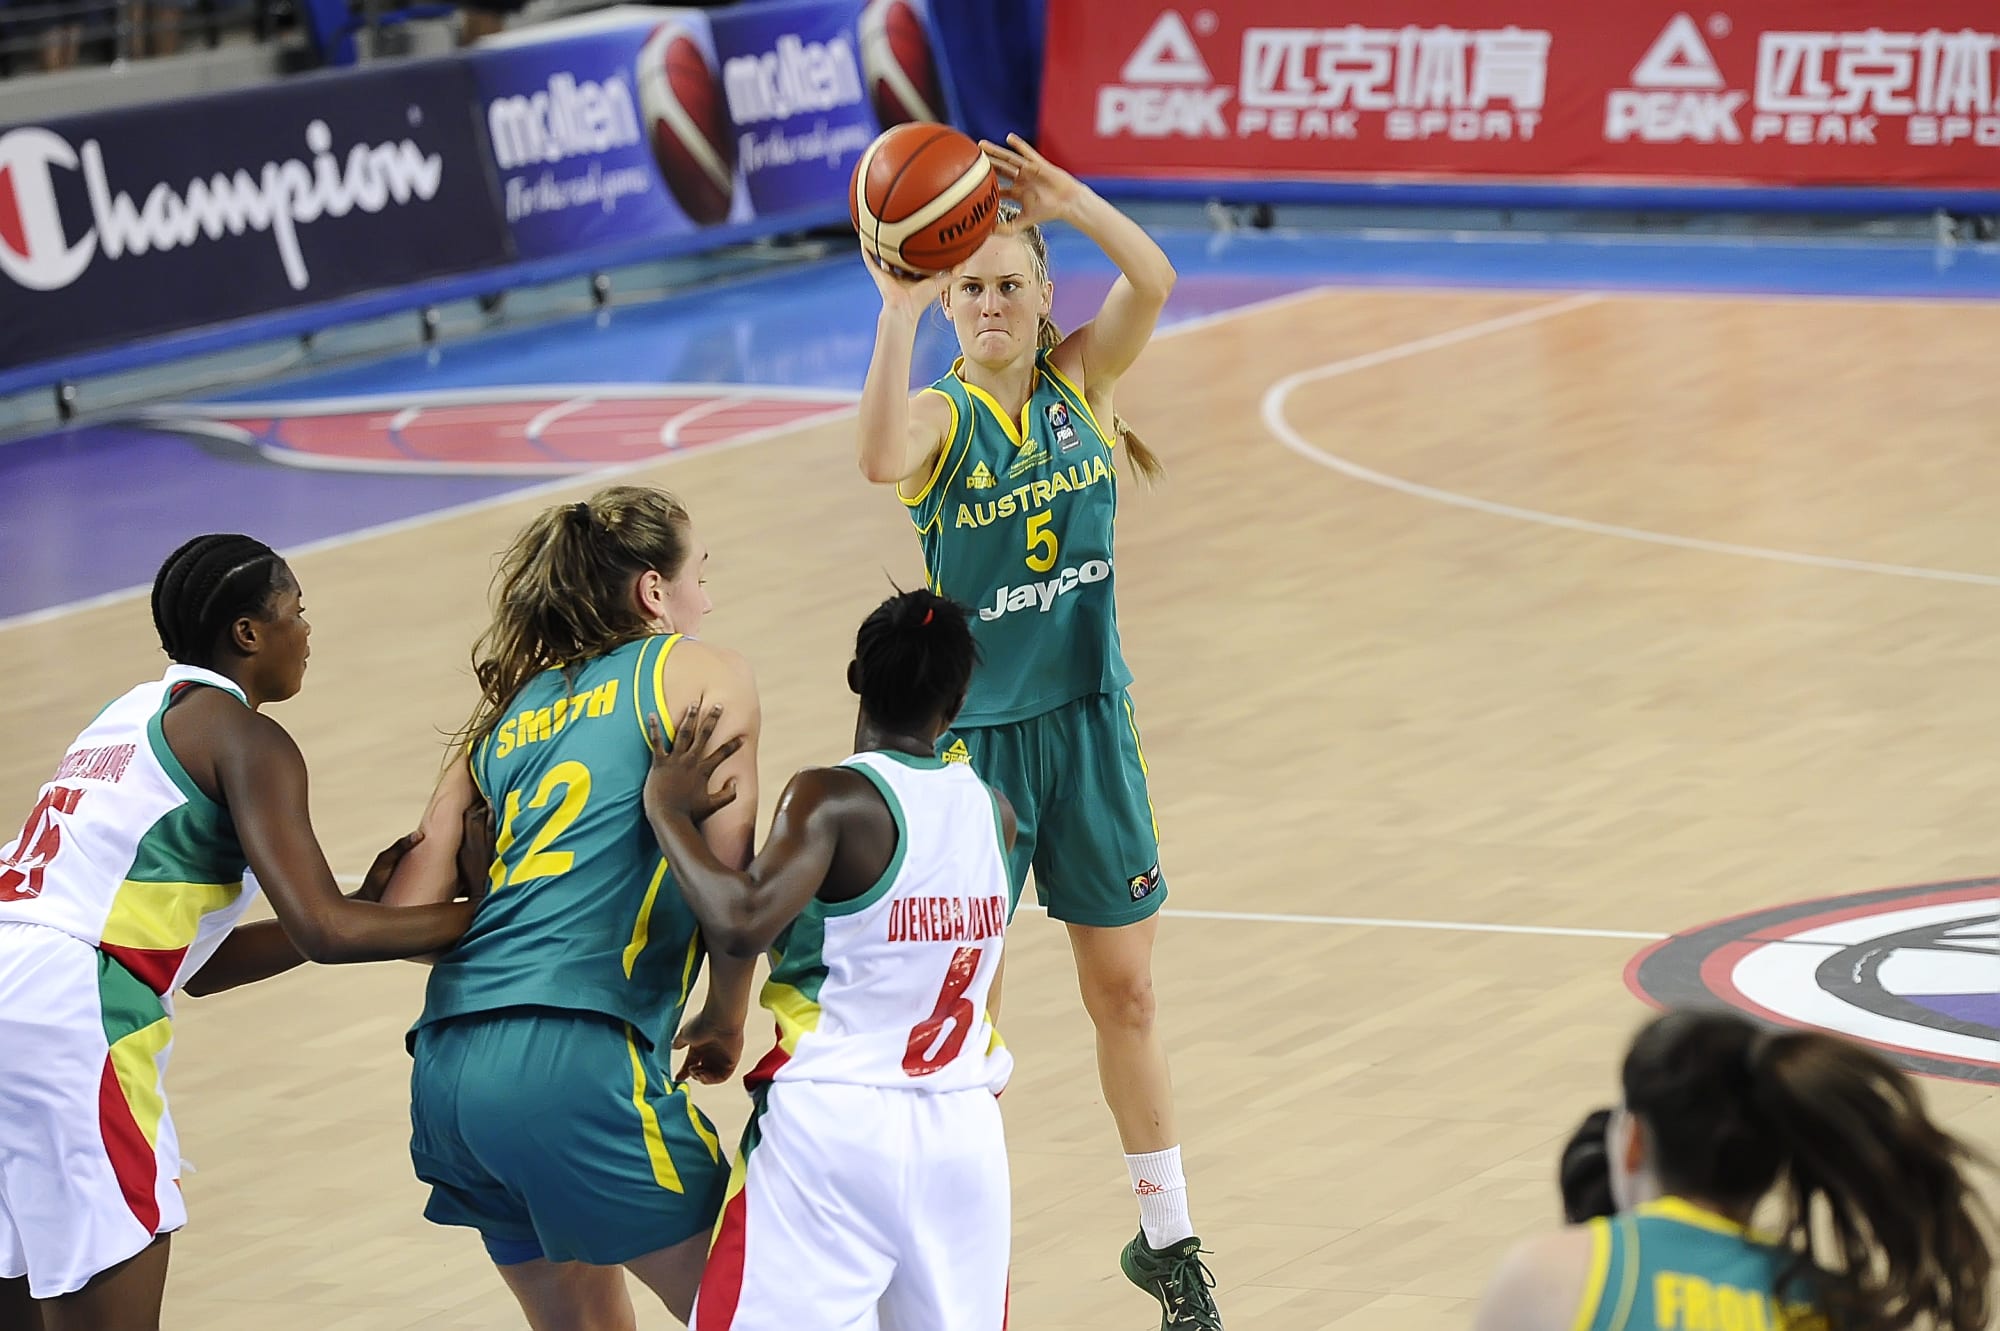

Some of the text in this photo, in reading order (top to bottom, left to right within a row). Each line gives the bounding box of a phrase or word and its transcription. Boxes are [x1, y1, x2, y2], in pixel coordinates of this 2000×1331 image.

[724, 35, 863, 125] molten
[1241, 25, 1552, 110] 匹克体育
[1754, 28, 2000, 115] 匹克体
[488, 71, 641, 169] molten
[1097, 85, 1233, 138] PEAK
[1237, 110, 1542, 140] PEAK SPORT
[1605, 89, 1749, 143] PEAK
[1752, 115, 1880, 145] PEAK
[0, 119, 442, 291] Champion
[955, 455, 1110, 529] AUSTRALIA
[1025, 508, 1059, 573] 5
[979, 559, 1110, 622] Jayco
[496, 679, 620, 759] SMITH
[488, 760, 592, 895] 12
[901, 946, 984, 1077] 6
